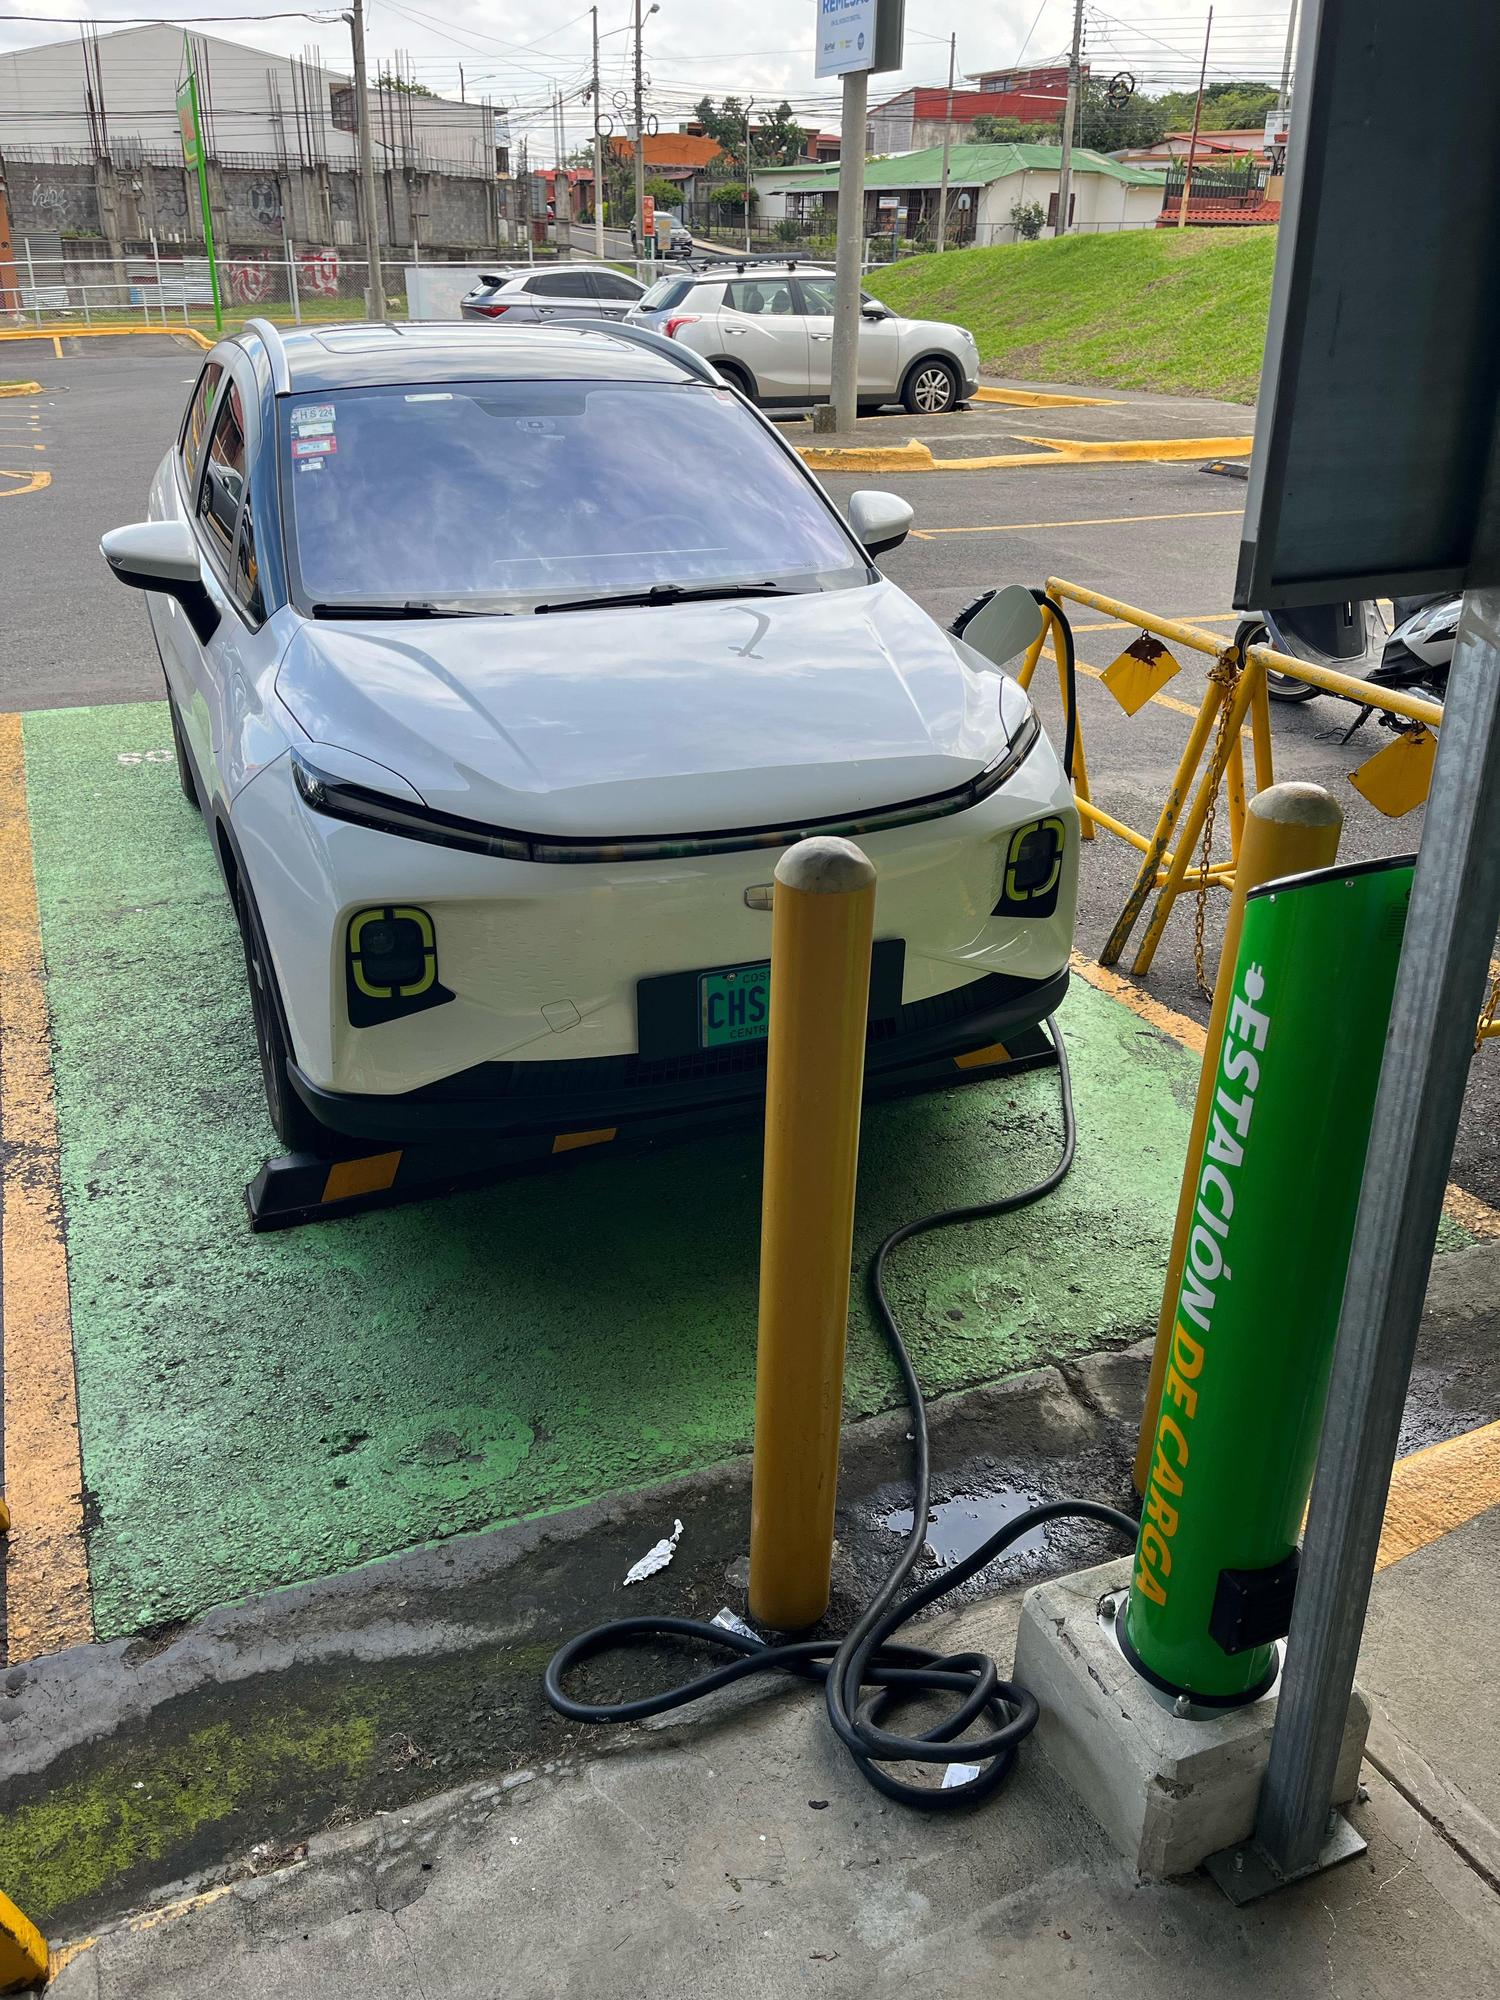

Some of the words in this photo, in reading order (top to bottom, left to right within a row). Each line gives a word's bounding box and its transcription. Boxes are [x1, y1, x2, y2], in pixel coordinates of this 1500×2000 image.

[708, 986, 766, 1029] CHS
[743, 971, 770, 983] COS
[729, 1024, 770, 1039] CENTR
[1181, 994, 1270, 1332] ESTACIÓN
[1166, 1320, 1205, 1420] DE
[1135, 1414, 1189, 1606] CARGA
